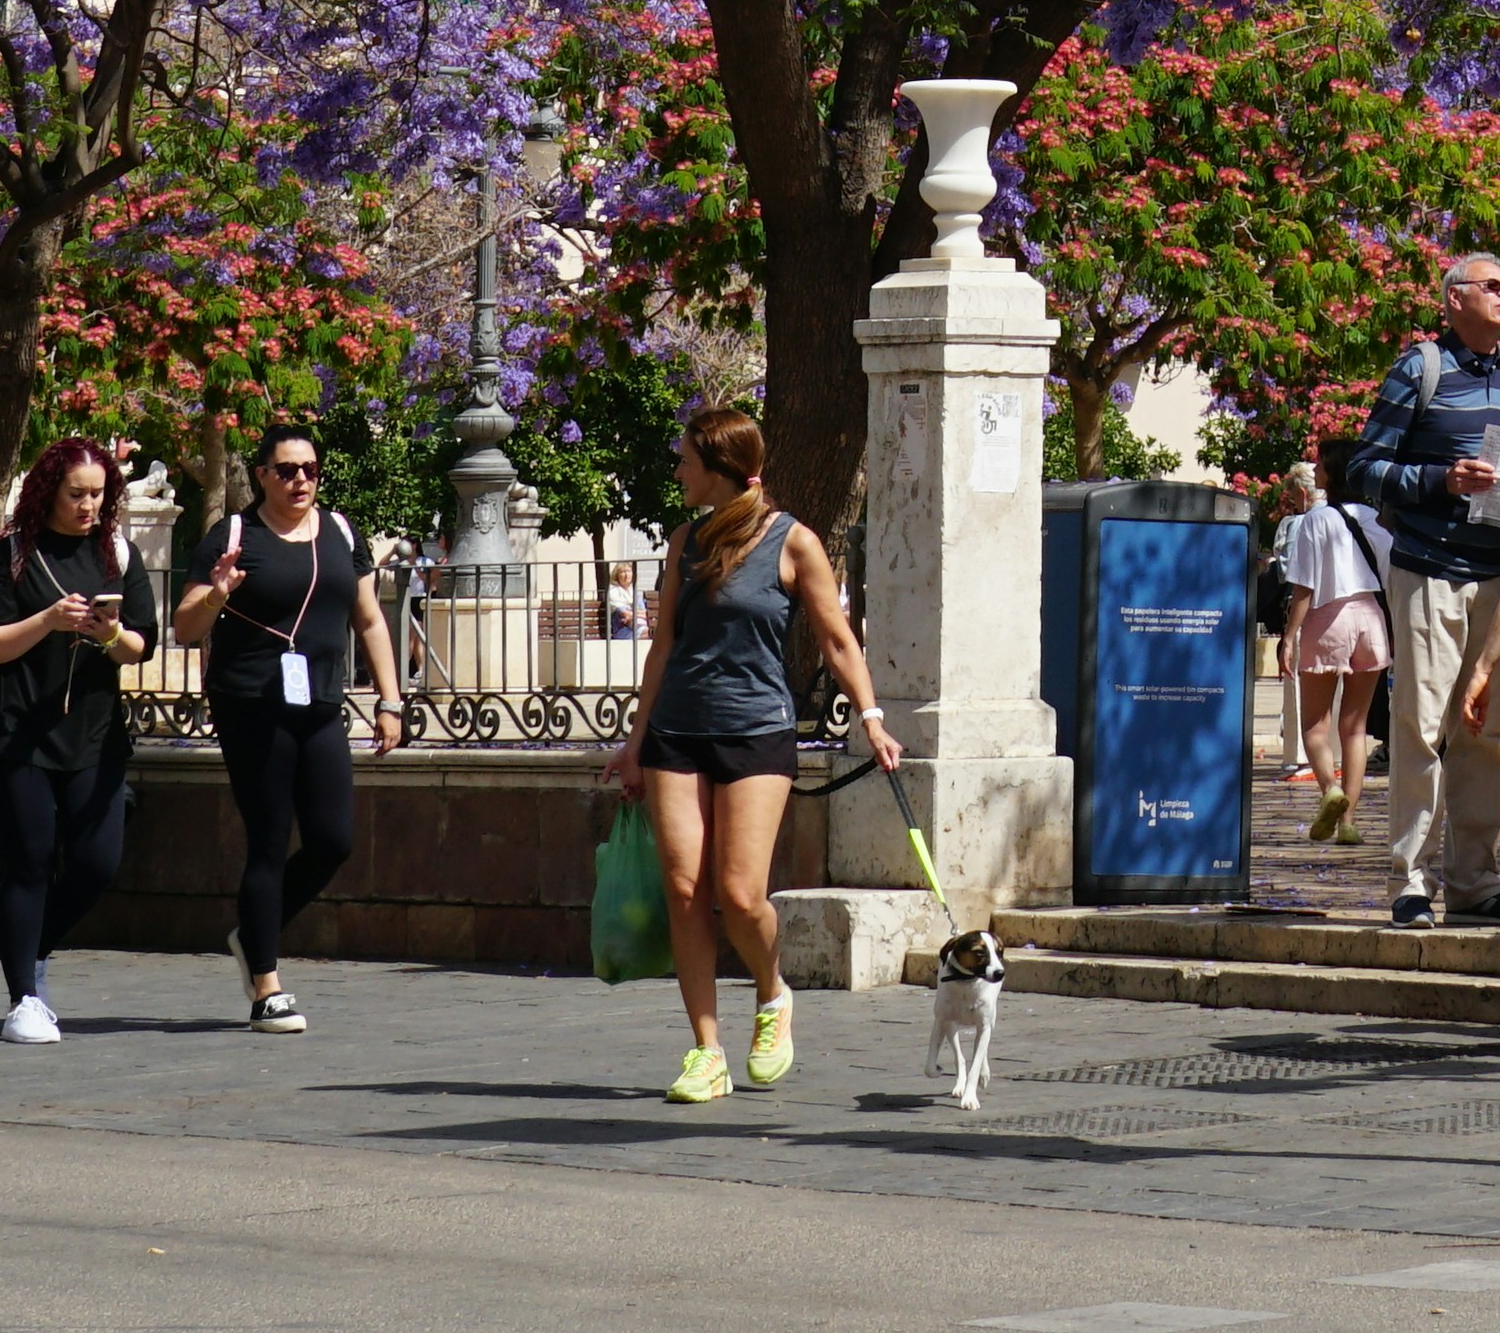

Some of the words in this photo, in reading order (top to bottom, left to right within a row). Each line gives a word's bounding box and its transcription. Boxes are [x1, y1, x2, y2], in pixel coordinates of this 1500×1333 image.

[1134, 607, 1160, 617] papelera
[1161, 608, 1193, 617] inteligente
[1134, 616, 1159, 624] residuos
[1159, 617, 1181, 625] usando
[1205, 618, 1219, 626] solar
[1130, 625, 1144, 633] para
[1145, 625, 1173, 633] aumentar
[1183, 626, 1212, 634] capacidad
[1115, 683, 1127, 691] This
[1182, 695, 1206, 703] capacity
[1160, 800, 1189, 809] Limpieza
[1160, 810, 1168, 819] de
[1169, 810, 1195, 820] Málaga
